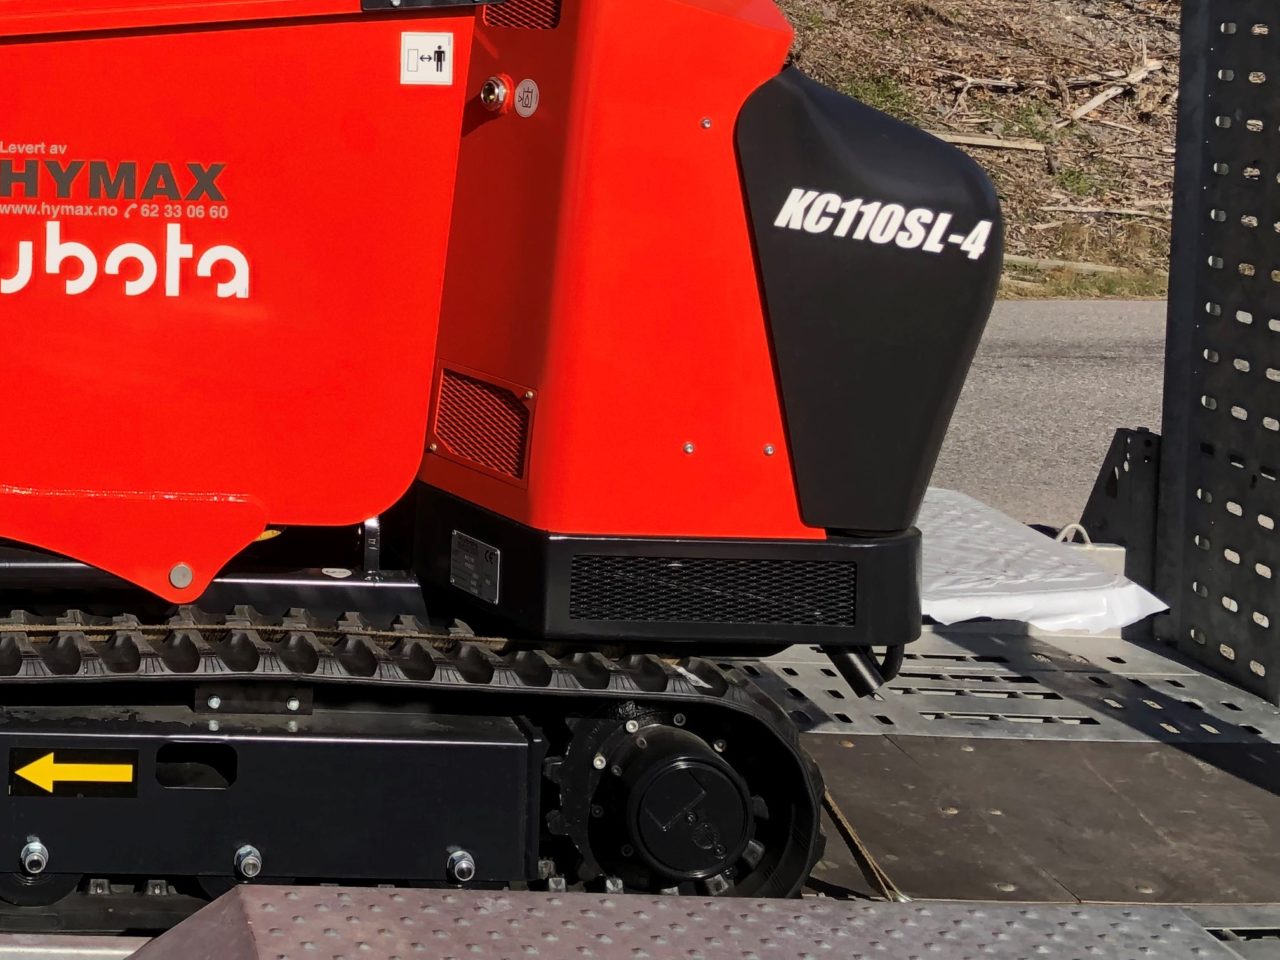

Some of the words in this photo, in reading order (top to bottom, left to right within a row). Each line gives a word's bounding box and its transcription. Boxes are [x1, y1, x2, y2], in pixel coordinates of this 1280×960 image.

[0, 141, 46, 155] Levert
[50, 142, 67, 155] av
[0, 159, 226, 202] HYMAX
[140, 205, 159, 218] 62
[164, 205, 182, 218] 33
[186, 206, 205, 219] 06
[209, 206, 228, 220] 60
[774, 188, 993, 260] KC110SL-4
